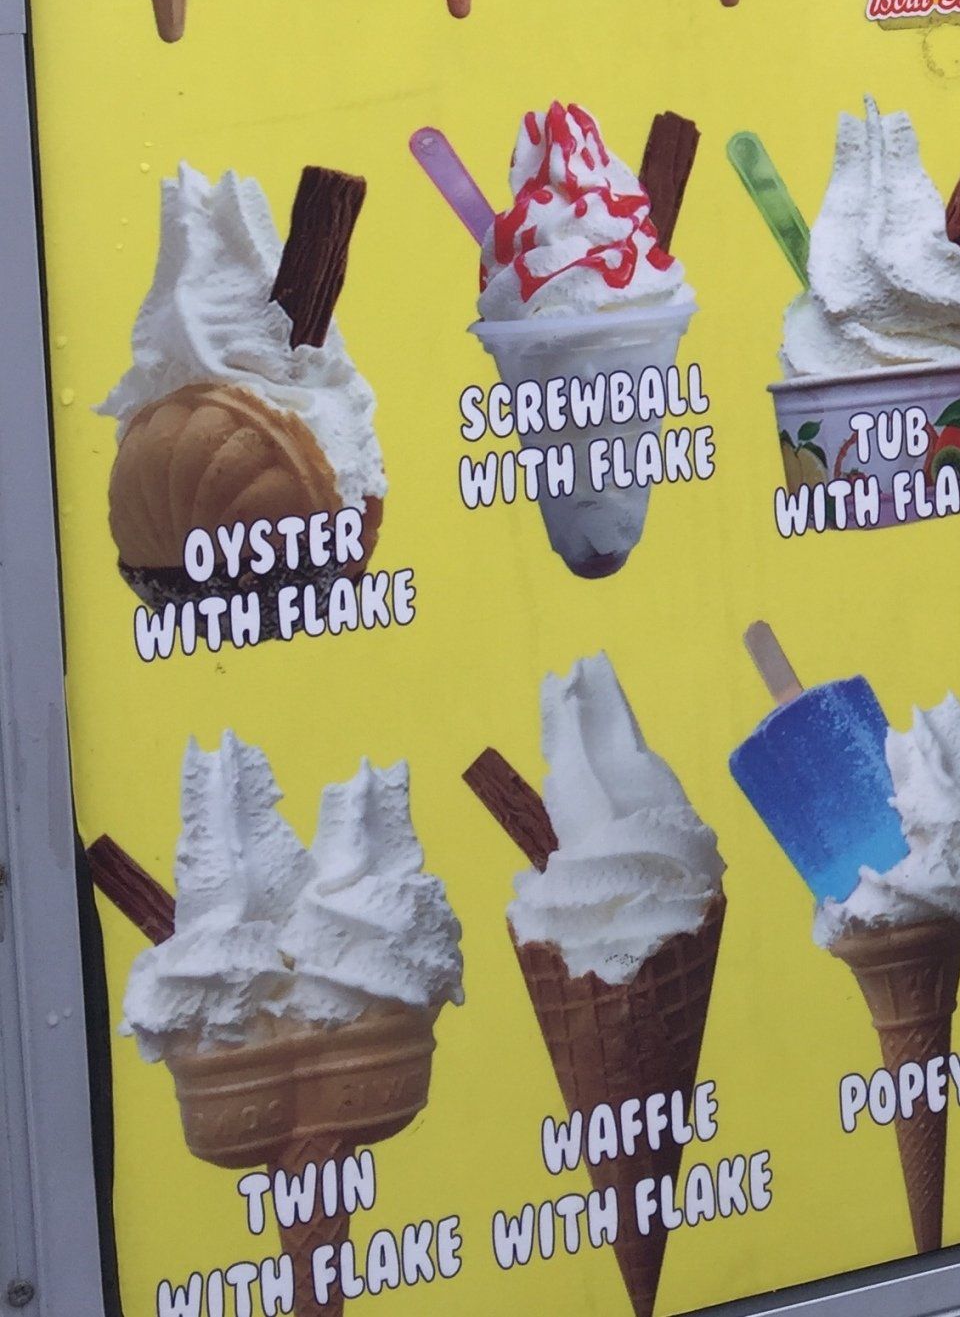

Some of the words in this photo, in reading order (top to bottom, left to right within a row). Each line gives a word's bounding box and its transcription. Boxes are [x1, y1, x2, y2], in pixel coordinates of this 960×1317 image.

[458, 362, 711, 442] SCREWBALL
[849, 405, 930, 464] TUB
[458, 440, 576, 510] WITH
[588, 425, 717, 492] FLAKE
[773, 476, 882, 539] WITH
[182, 506, 365, 585] OYSTER
[133, 584, 262, 663] WITH
[277, 567, 417, 639] FLAKE
[540, 1079, 719, 1176] WAFFLE
[237, 1149, 377, 1236] TWIN
[491, 1188, 619, 1271] WITH
[634, 1149, 773, 1238] FLAKE
[155, 1252, 296, 1317] WITH
[311, 1214, 464, 1306] FLAKE
